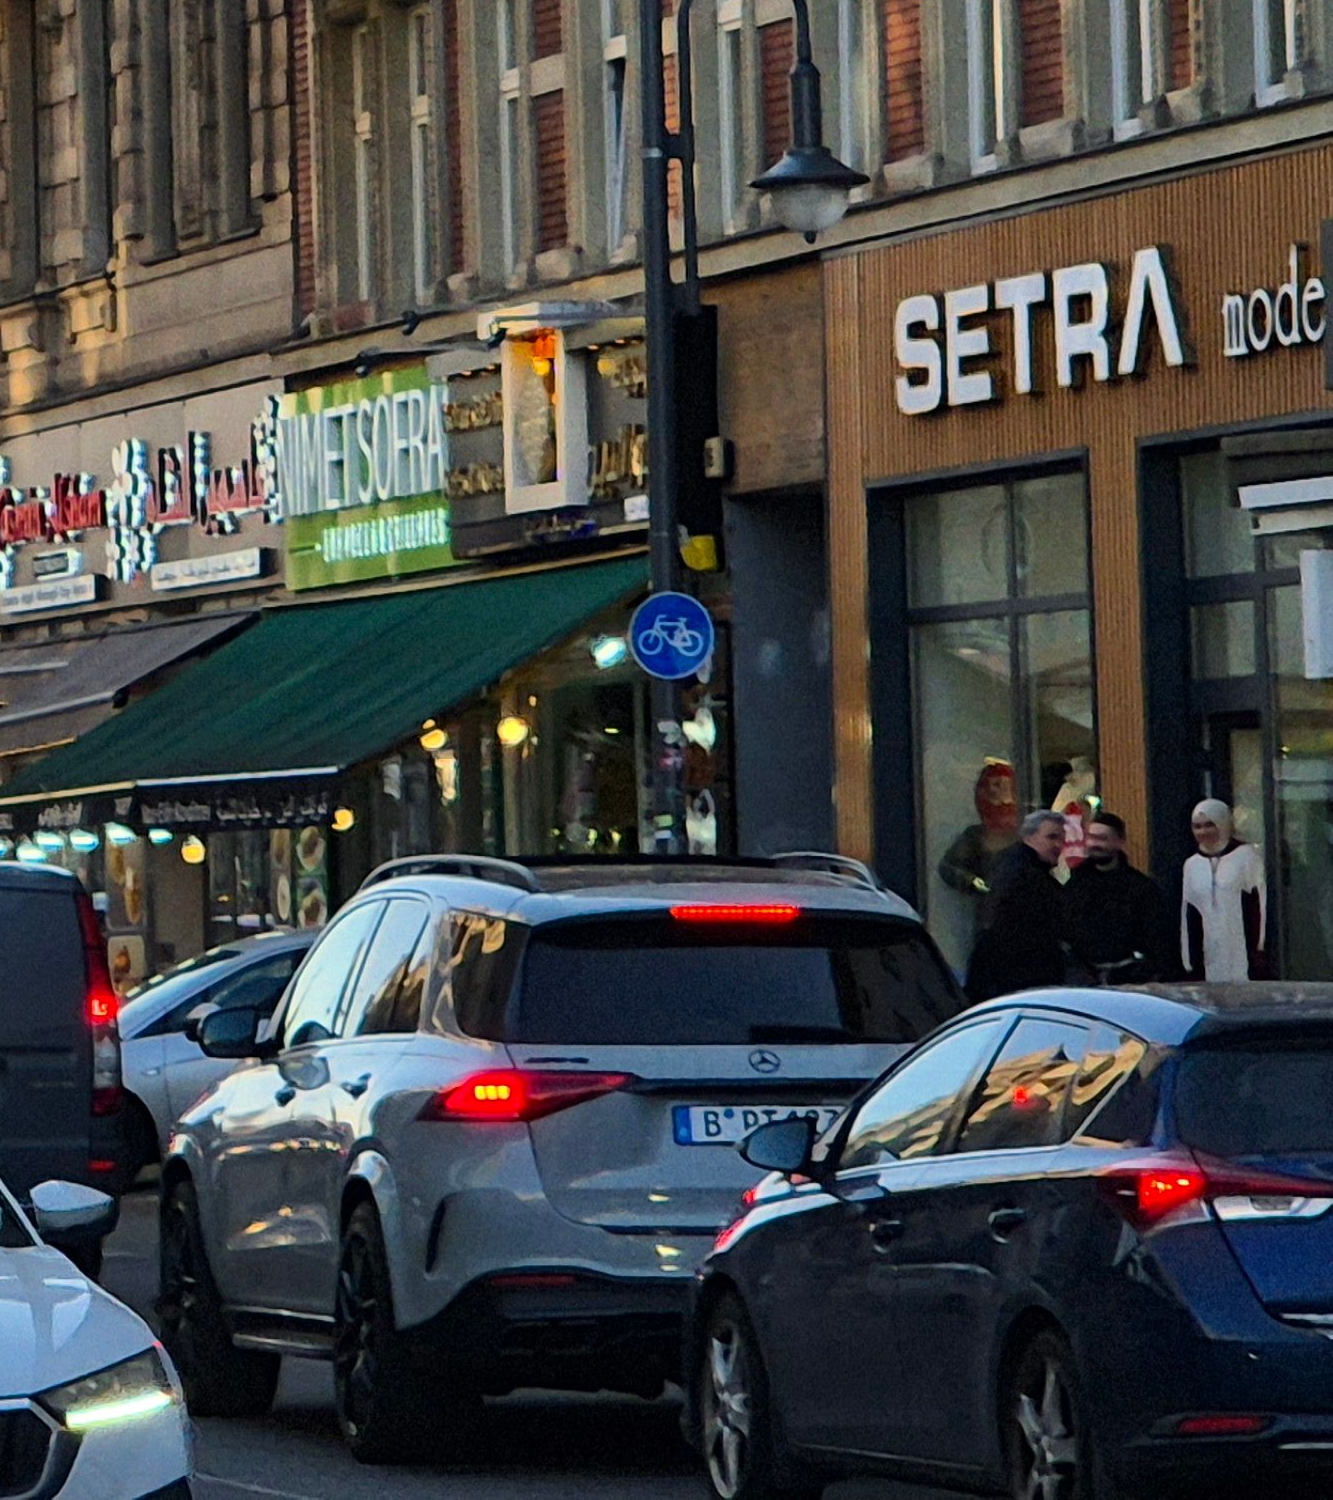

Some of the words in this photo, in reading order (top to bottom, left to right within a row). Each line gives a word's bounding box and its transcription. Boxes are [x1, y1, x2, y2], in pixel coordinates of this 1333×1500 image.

[895, 246, 1183, 416] SETRA
[357, 385, 445, 504] SOFRA
[703, 1110, 722, 1138] B
